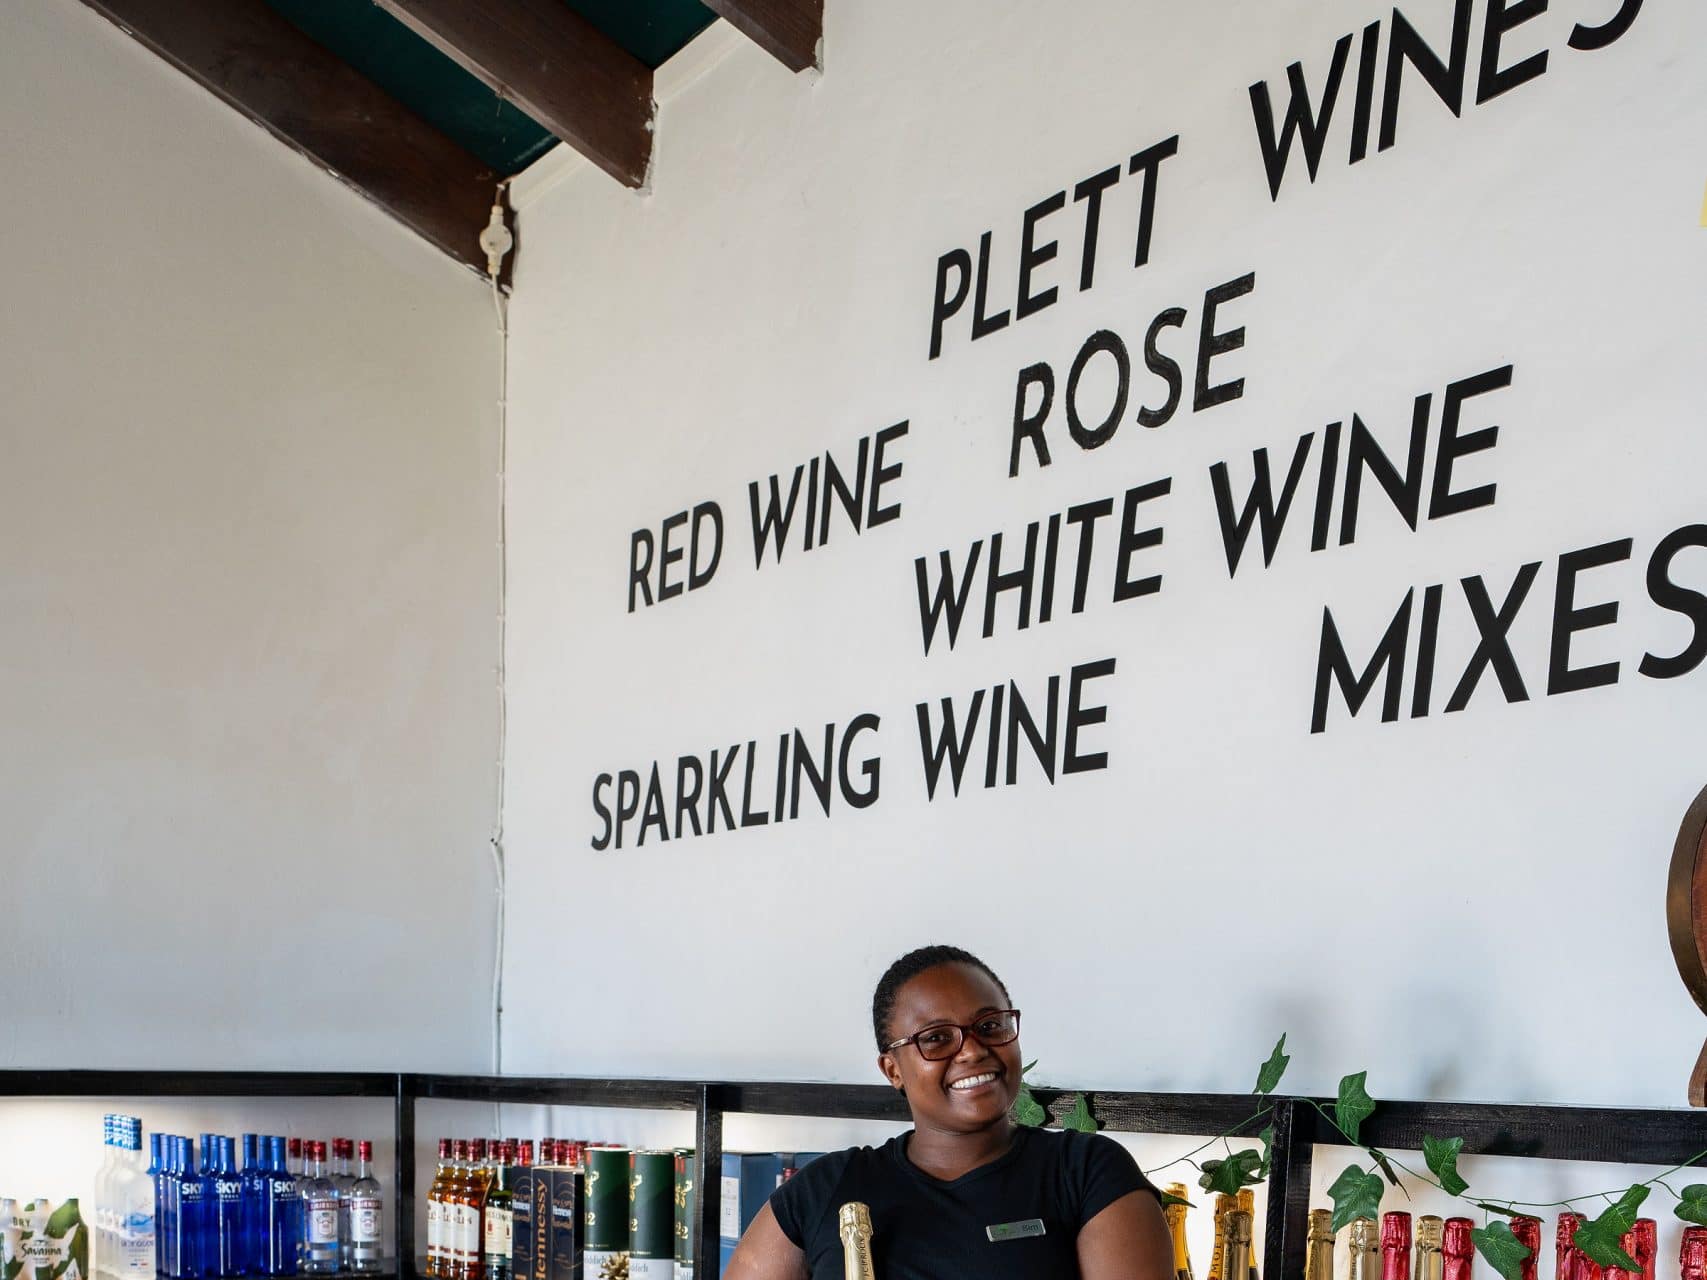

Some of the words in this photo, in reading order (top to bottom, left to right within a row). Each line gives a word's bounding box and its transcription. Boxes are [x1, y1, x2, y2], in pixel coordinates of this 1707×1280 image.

[1249, 0, 1643, 202] WINE
[929, 135, 1178, 360] PLETT
[1008, 272, 1255, 477] ROSE
[629, 502, 723, 612] RED
[749, 420, 909, 569] WINE
[915, 477, 1171, 656] WHITE
[1210, 365, 1513, 578] WINE
[1311, 524, 1707, 734] MIXES
[590, 714, 880, 851] SPARKLING
[917, 658, 1115, 801] WINE
[21, 1242, 62, 1258] Savanna
